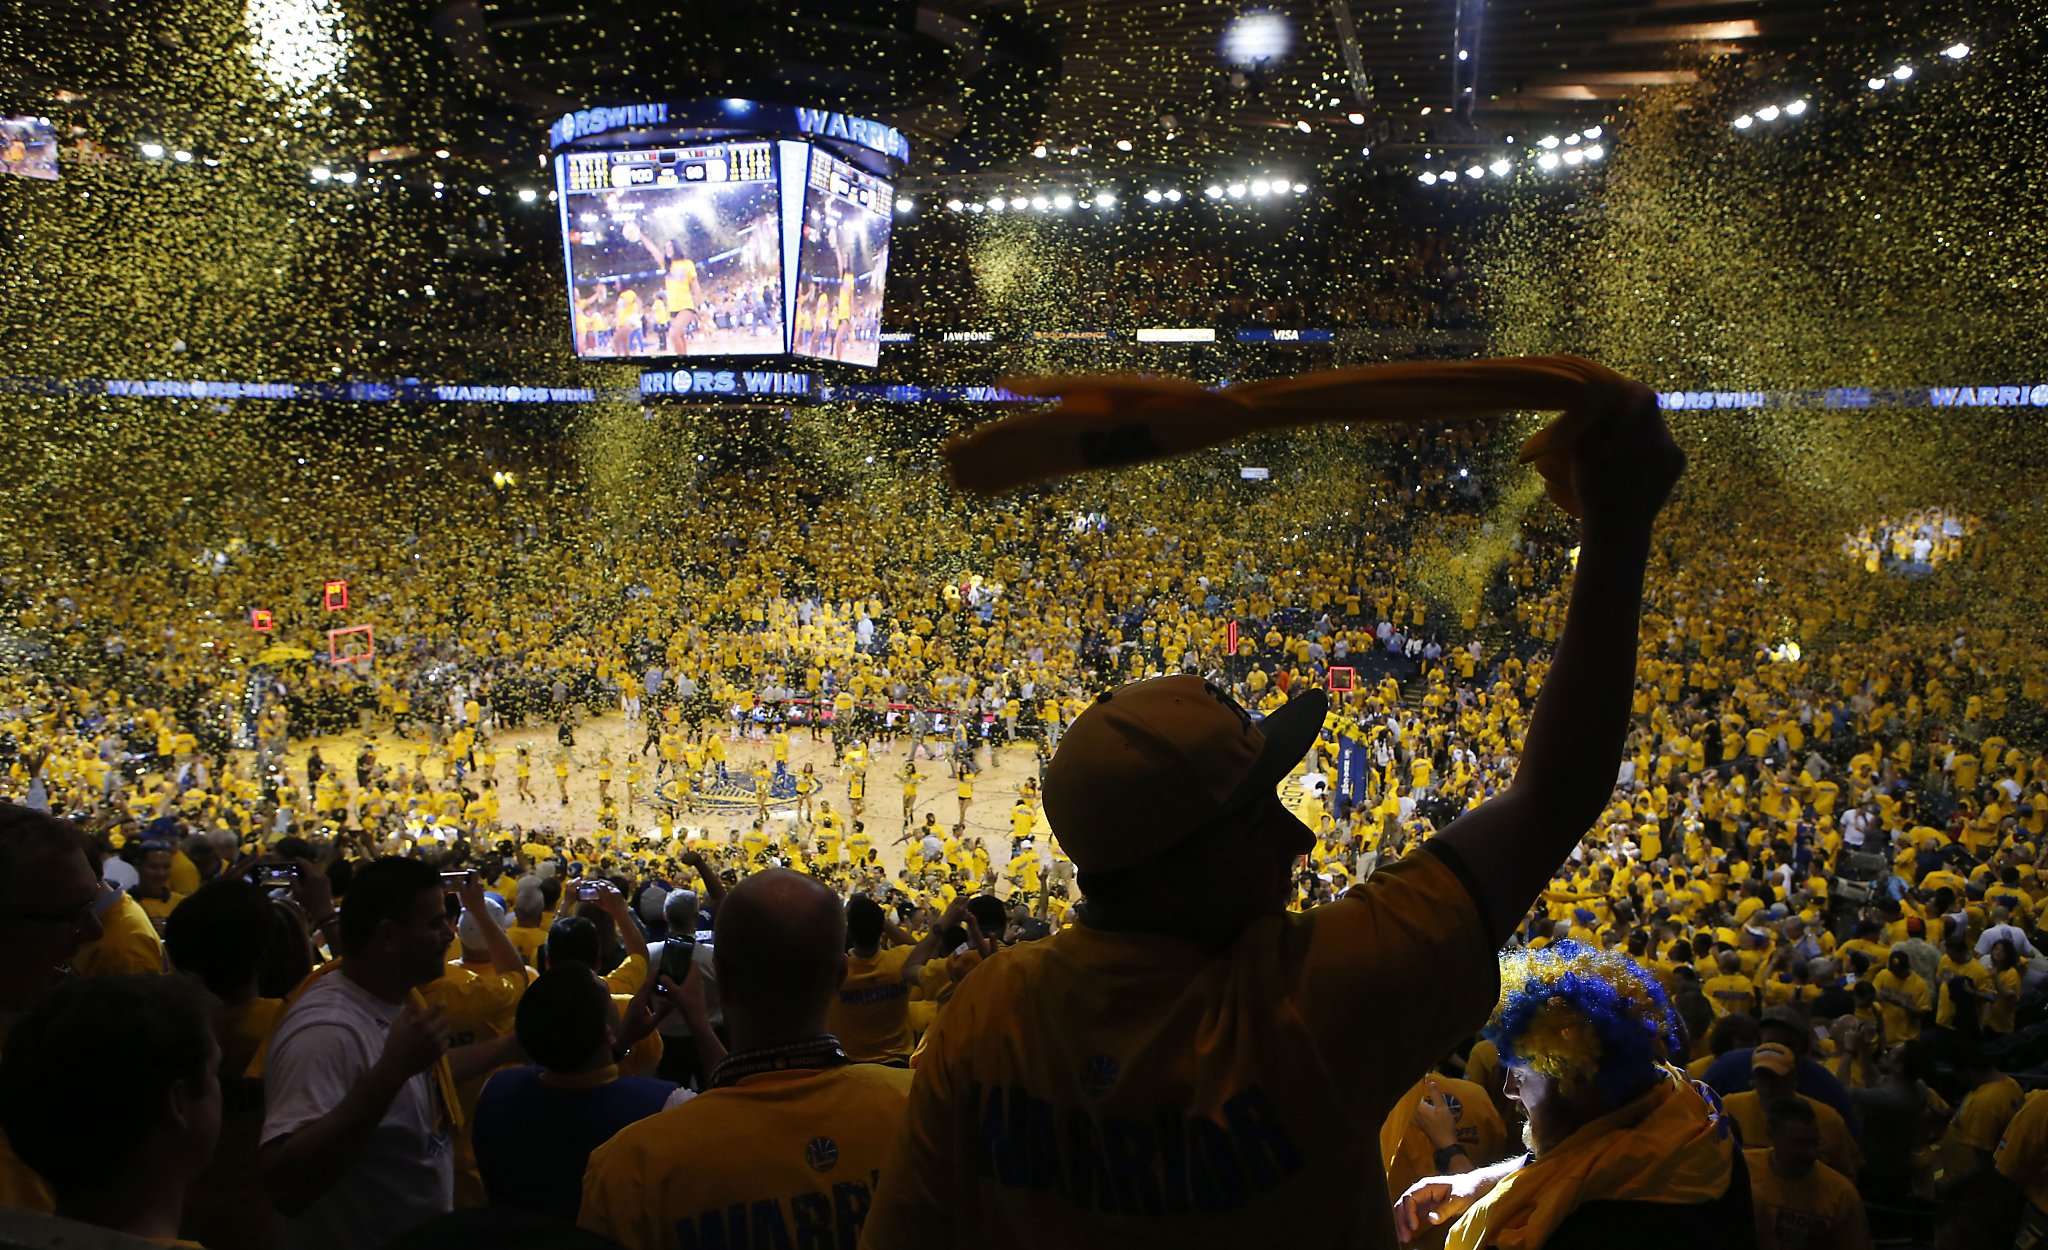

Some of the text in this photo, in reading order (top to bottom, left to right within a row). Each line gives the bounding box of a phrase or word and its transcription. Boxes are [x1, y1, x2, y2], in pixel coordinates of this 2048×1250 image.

[607, 103, 669, 128] WIN!
[880, 332, 911, 342] OMPANY
[943, 331, 994, 342] JAWBONE
[1273, 329, 1300, 341] VISA
[105, 380, 242, 399] WARRIORS
[743, 371, 810, 394] WIN!
[437, 385, 596, 403] WARRIORS WIN!
[1714, 391, 1766, 409] WIN!
[675, 1168, 880, 1250] WARR
